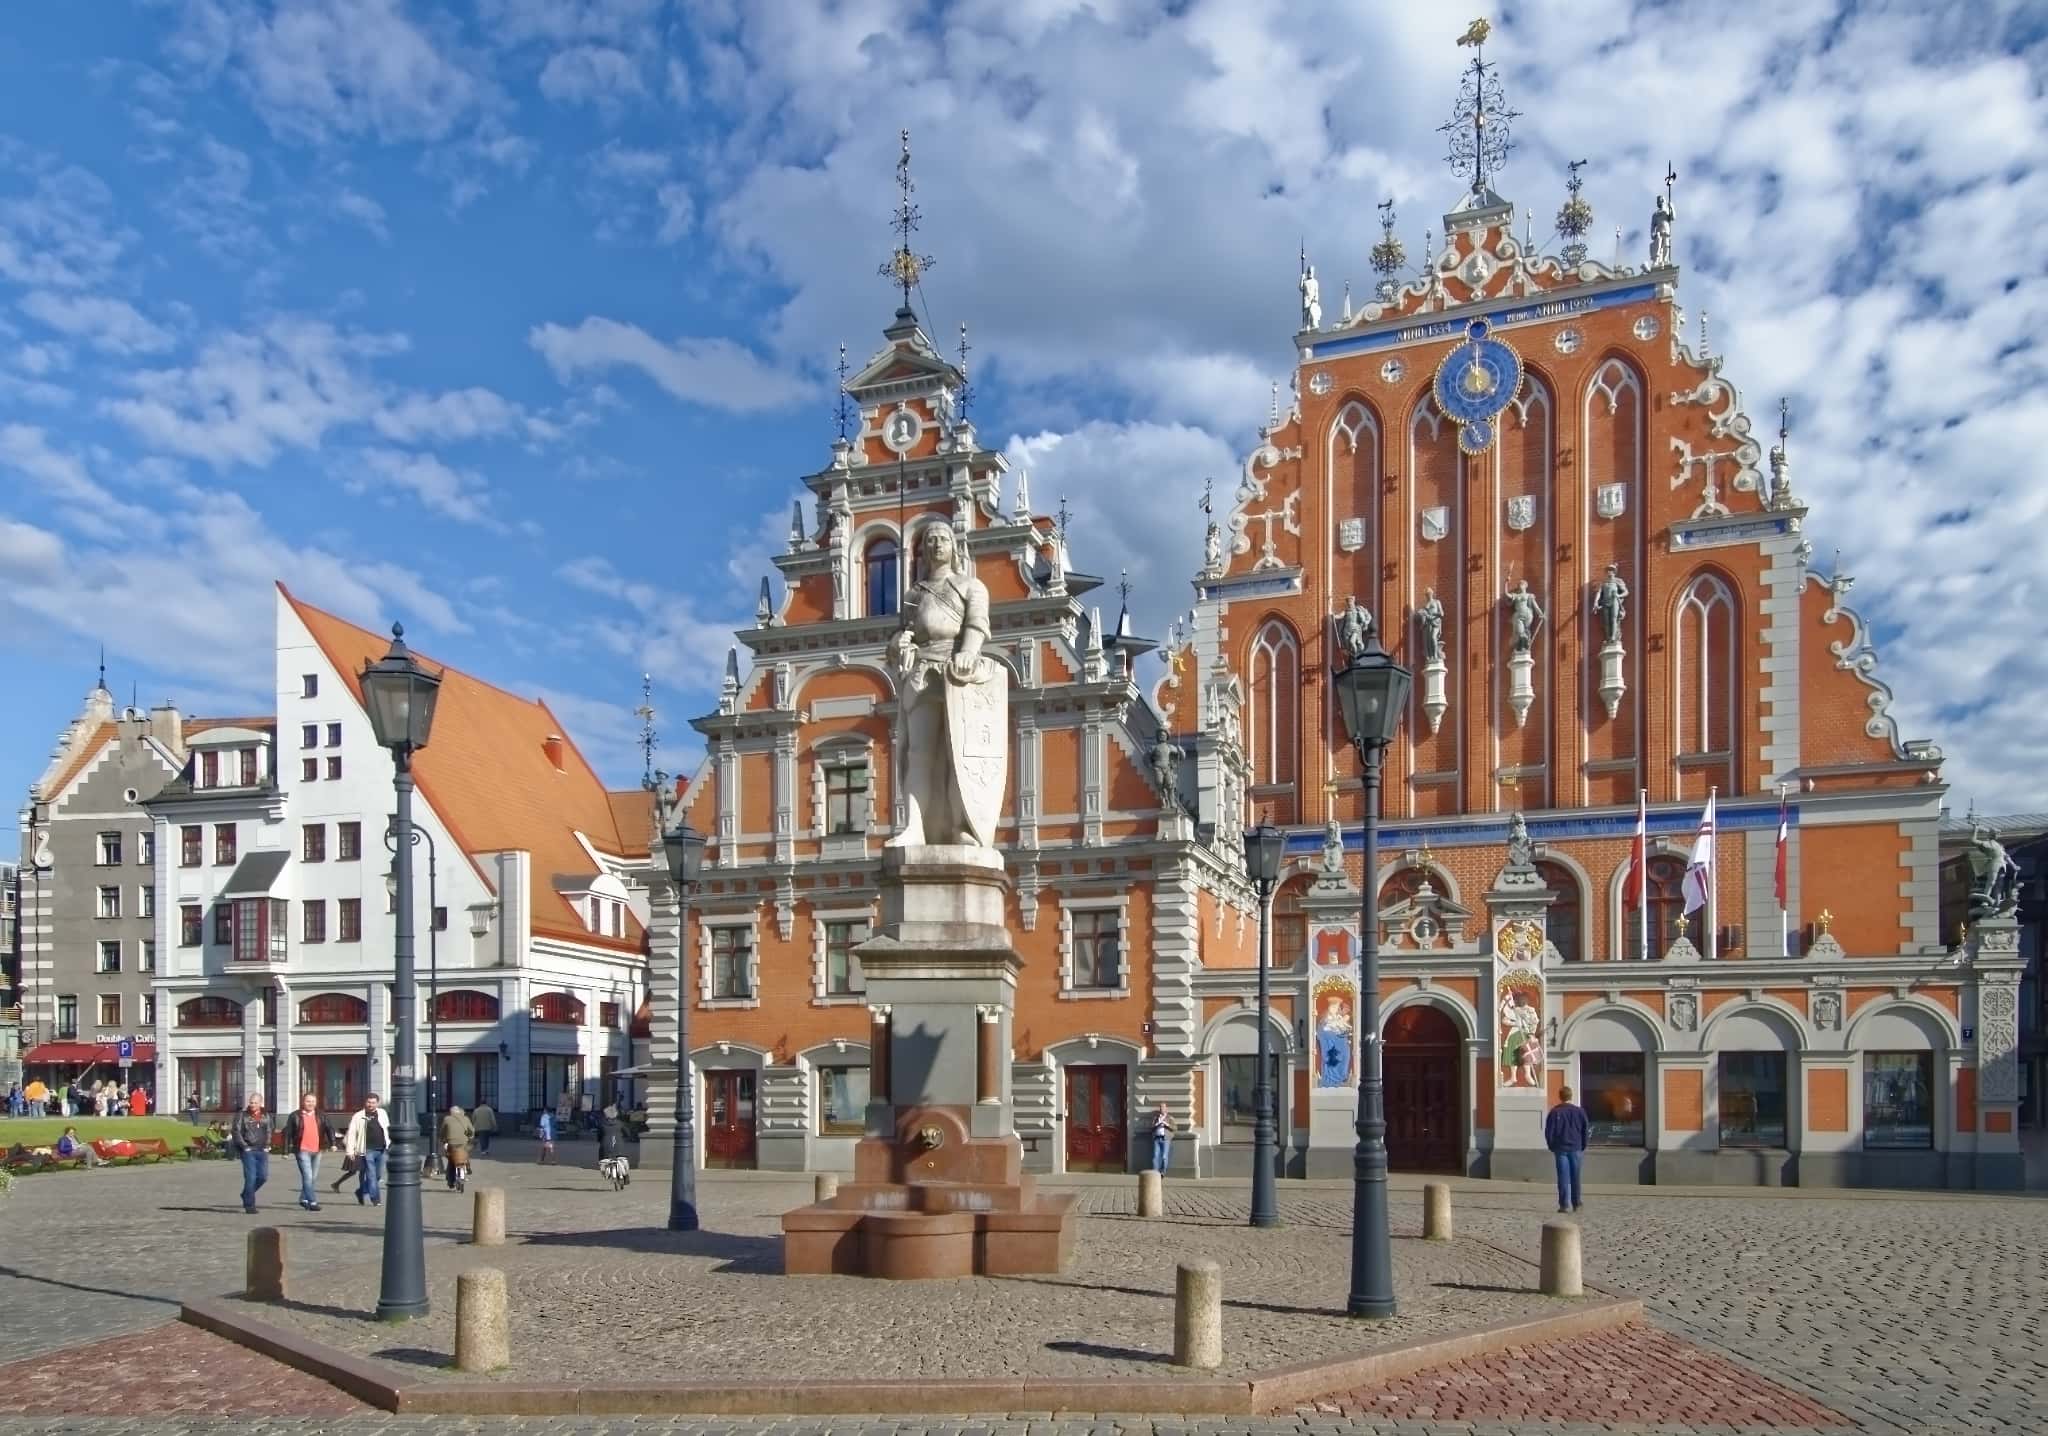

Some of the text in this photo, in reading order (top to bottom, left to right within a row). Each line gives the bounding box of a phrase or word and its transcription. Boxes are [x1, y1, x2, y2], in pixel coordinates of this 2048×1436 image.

[1534, 302, 1566, 318] ANNO
[1394, 327, 1424, 342] ANNO
[121, 1042, 129, 1055] P
